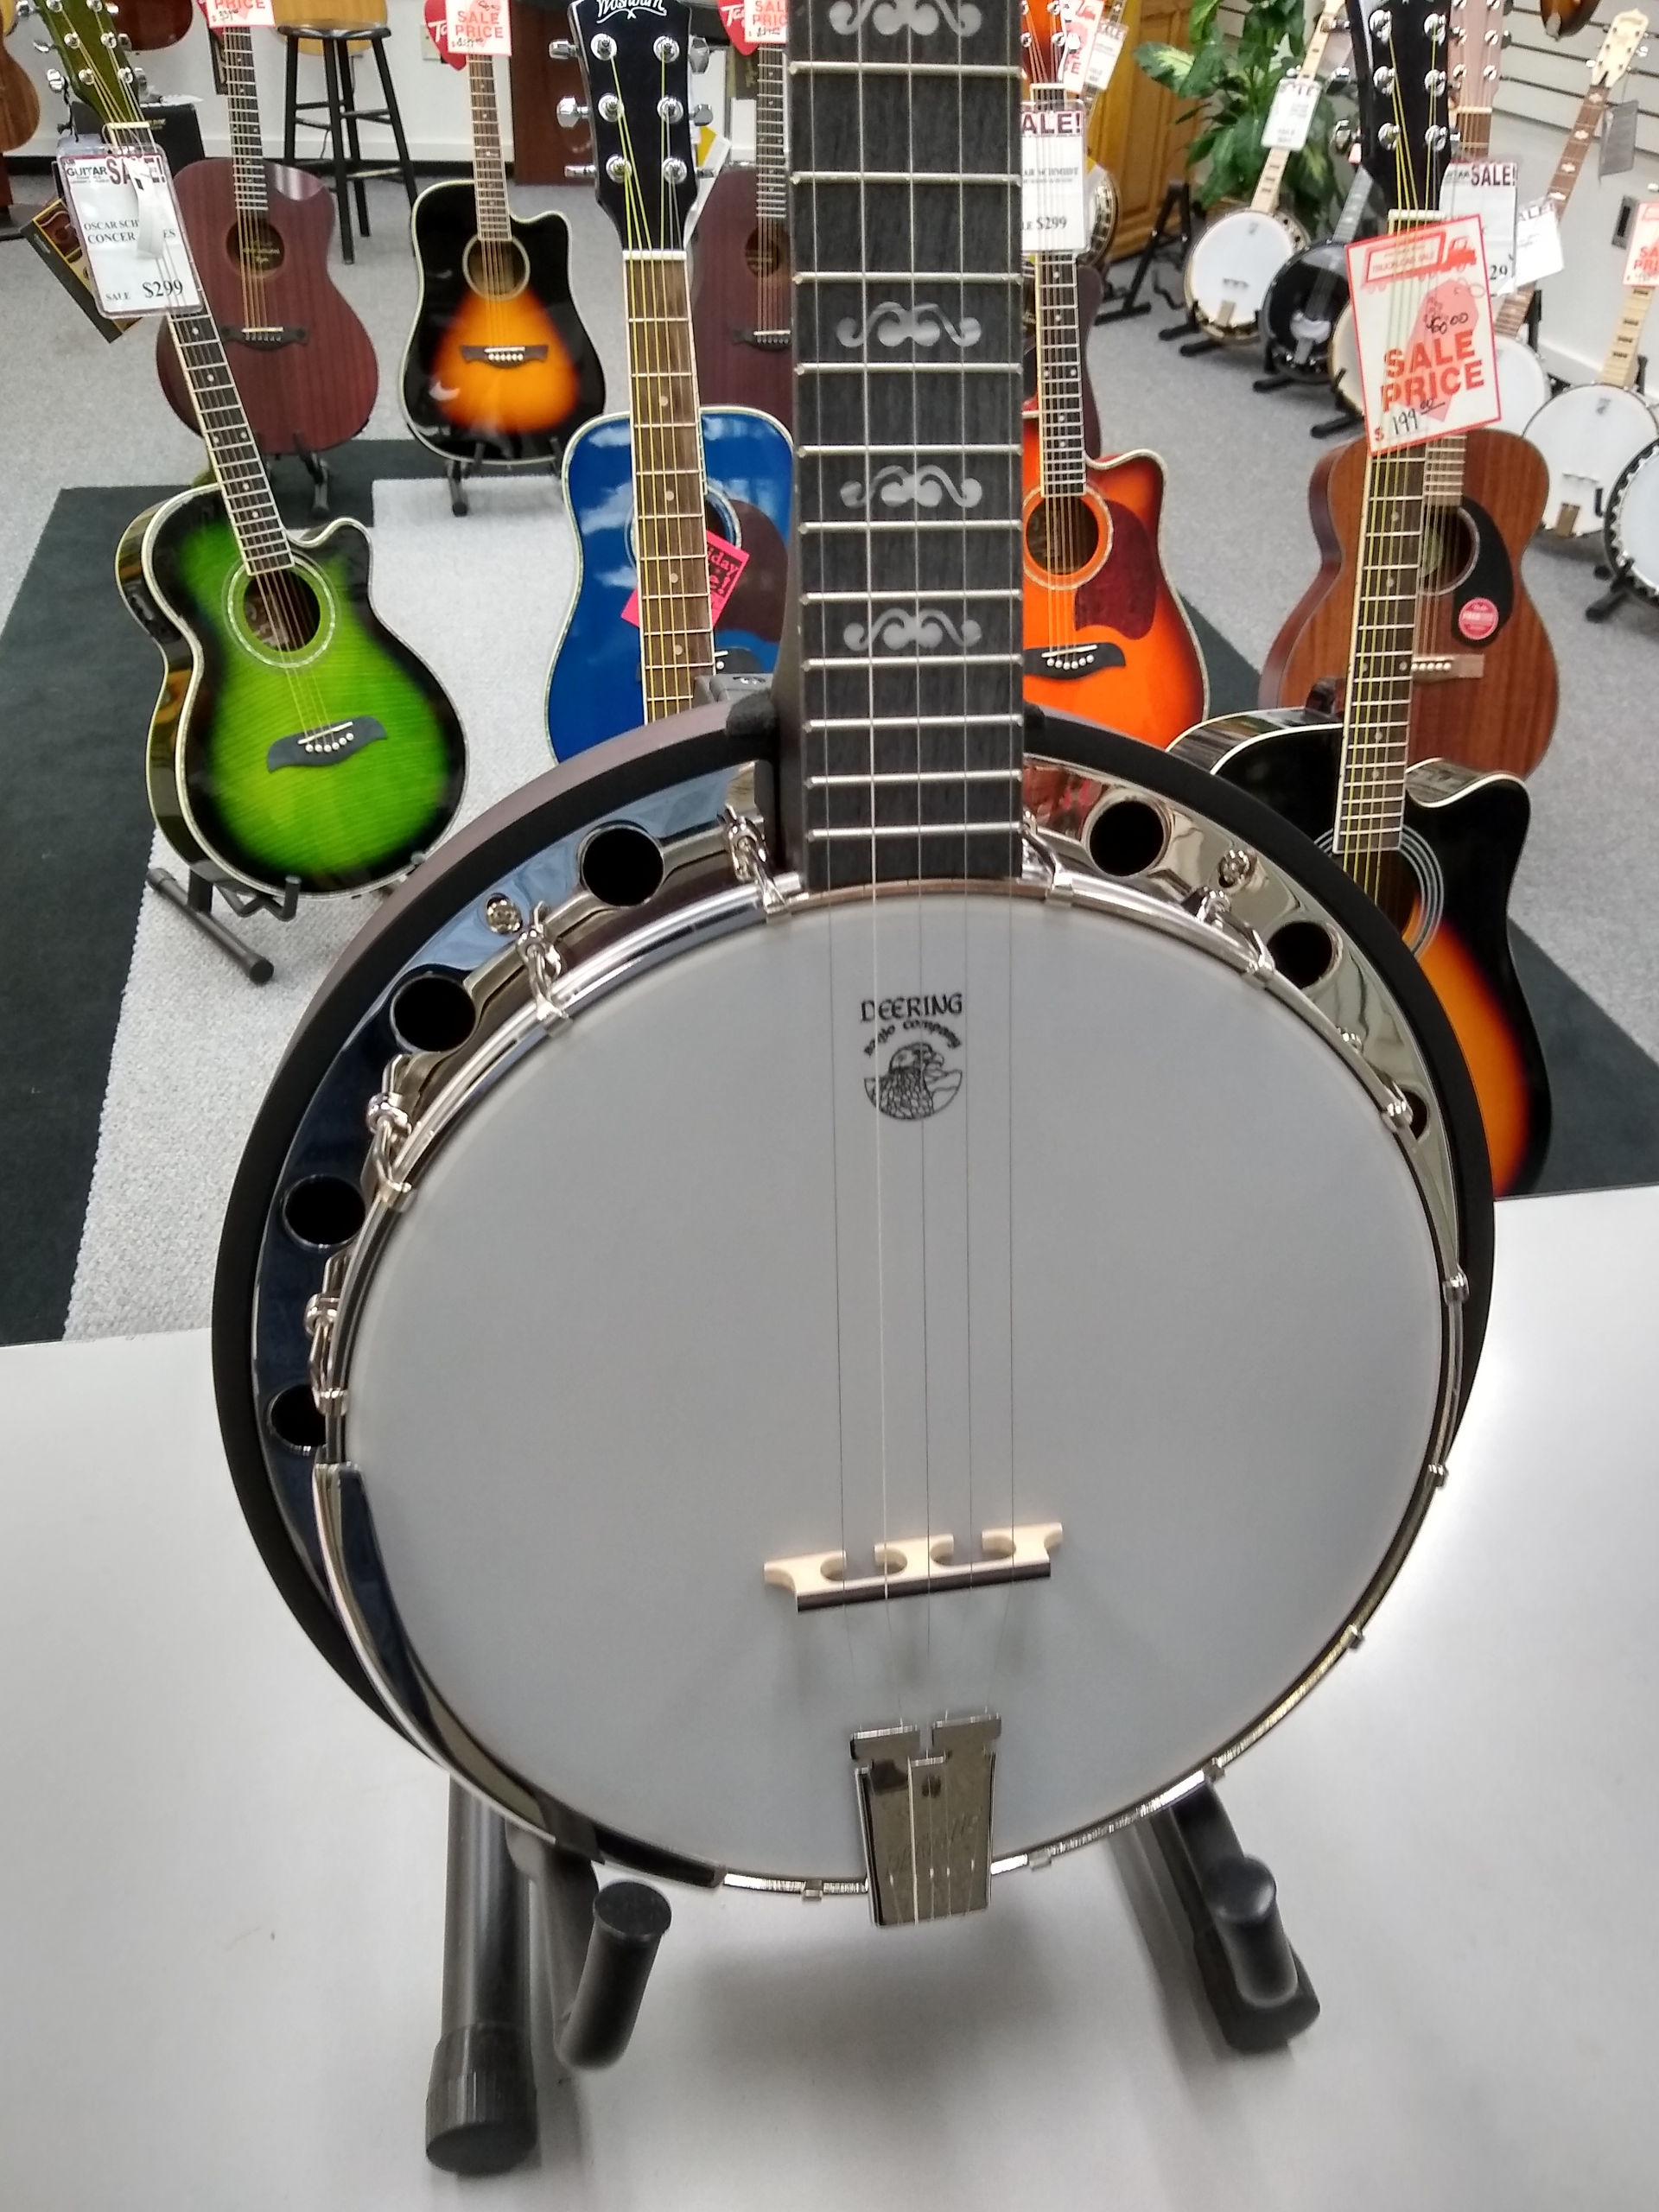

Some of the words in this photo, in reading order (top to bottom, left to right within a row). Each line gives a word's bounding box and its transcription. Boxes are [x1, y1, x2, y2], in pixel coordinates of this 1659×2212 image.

[755, 0, 785, 12] SAL
[457, 10, 499, 24] SALE
[753, 14, 787, 26] PRIC
[455, 25, 504, 38] PRICE
[1022, 112, 1084, 134] ALE!
[67, 166, 107, 176] GUITAR
[1471, 163, 1516, 187] SALE!
[1518, 201, 1555, 221] ALE!
[84, 219, 117, 231] OSCAR
[1036, 216, 1067, 230] $299
[87, 232, 137, 245] CONCER
[1640, 247, 1659, 257] SA
[1490, 264, 1509, 280] 29
[1633, 260, 1659, 270] PRI
[105, 292, 130, 302] SALE
[142, 279, 184, 298] $299
[1384, 330, 1476, 378] SALE
[1381, 359, 1485, 412] PRICE
[861, 993, 963, 1023] DEERING
